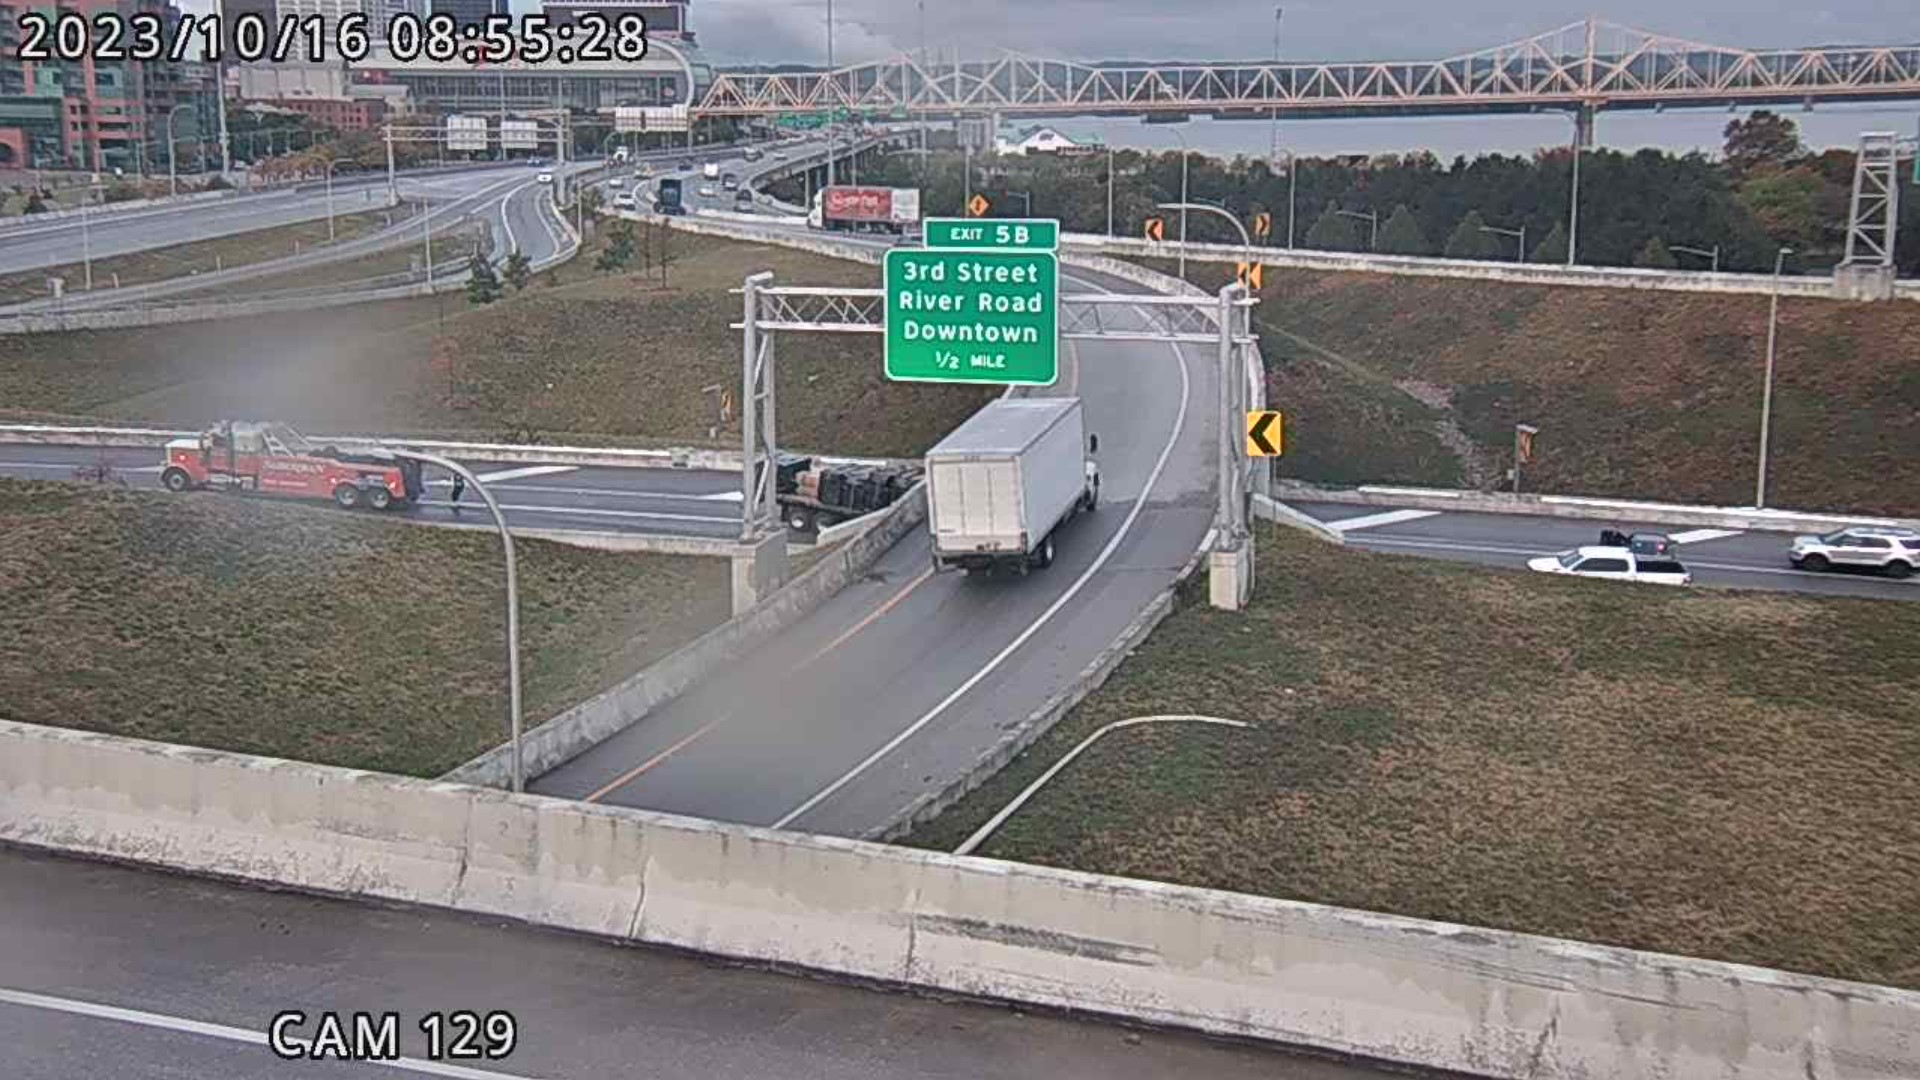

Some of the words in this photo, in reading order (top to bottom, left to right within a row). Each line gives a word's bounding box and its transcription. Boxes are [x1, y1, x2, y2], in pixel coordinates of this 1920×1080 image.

[950, 227, 983, 241] EXIT
[995, 225, 1030, 244] 5B
[903, 261, 945, 282] 3rd
[957, 262, 1038, 283] Street
[899, 290, 965, 311] River
[978, 292, 1043, 313] Road
[903, 320, 1039, 343] Downtown
[970, 354, 1006, 369] MILE
